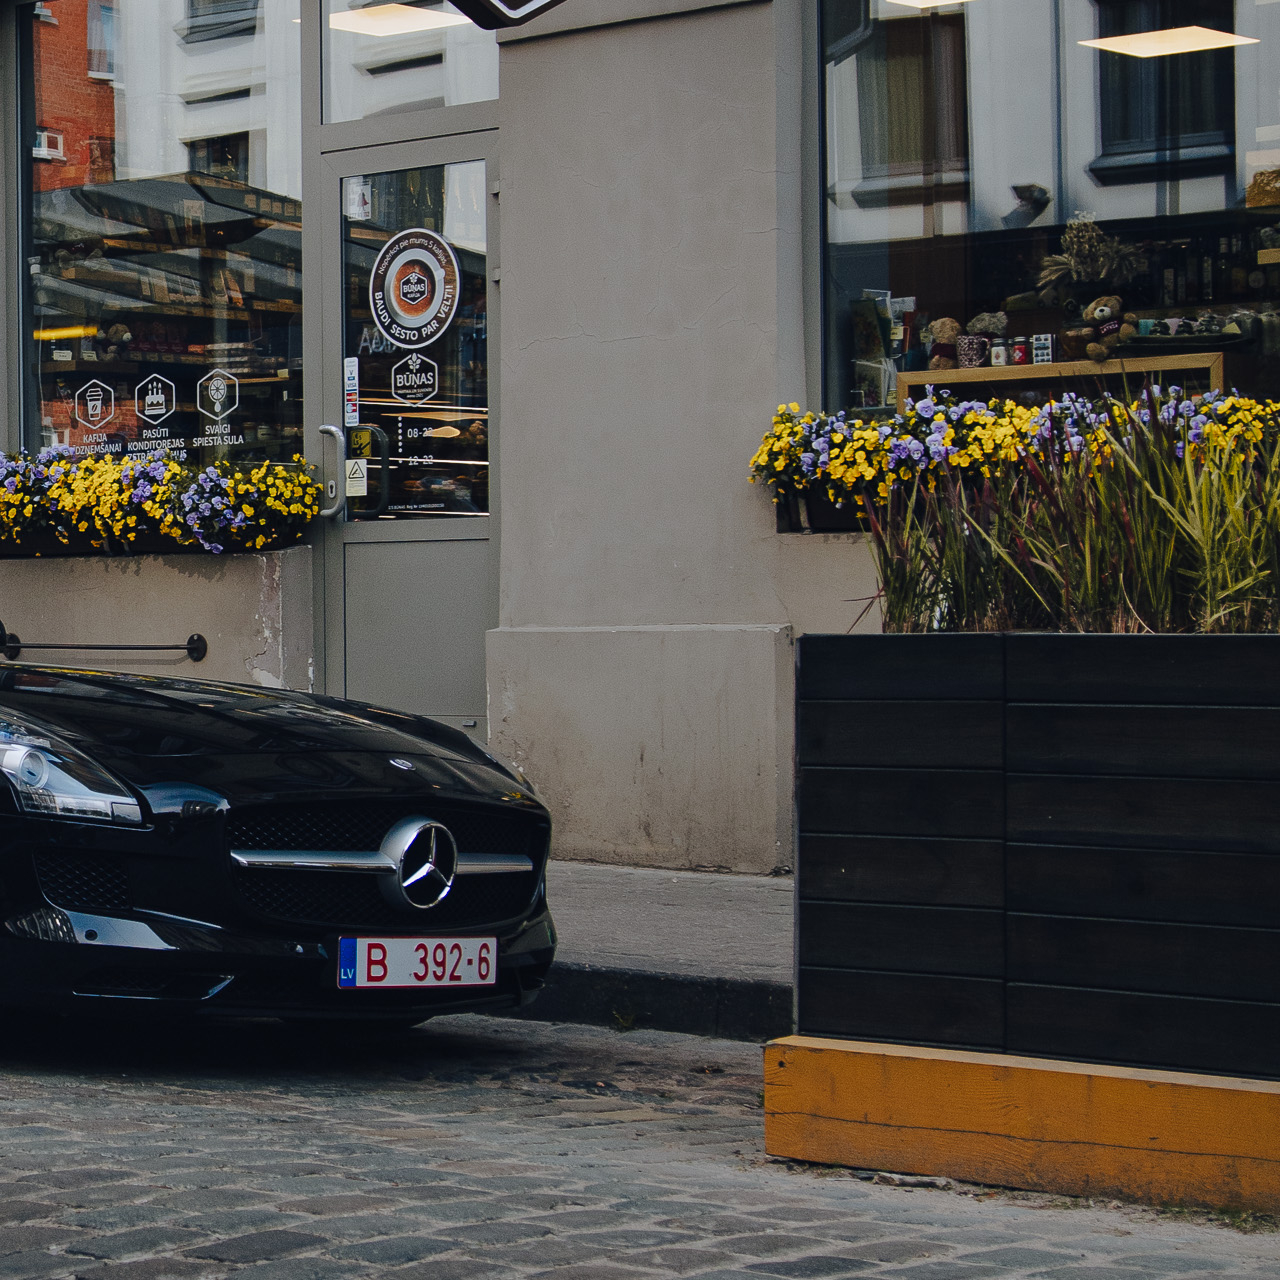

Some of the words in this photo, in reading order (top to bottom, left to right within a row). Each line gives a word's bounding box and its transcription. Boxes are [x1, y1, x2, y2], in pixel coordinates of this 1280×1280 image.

[399, 240, 409, 250] pie
[410, 238, 428, 246] mums
[375, 292, 392, 326] BAUDI
[390, 324, 419, 341] SESTO
[422, 320, 439, 338] PAR
[396, 372, 434, 388] BŪŅAS
[143, 427, 169, 439] PASŪTI
[205, 424, 231, 435] SVAIGI
[83, 433, 108, 444] KAFIJA
[193, 436, 223, 447] SPIESTA
[223, 435, 244, 445] SULA
[73, 443, 122, 457] DZŅEMŠANAI
[128, 439, 185, 451] KONDITOREJAS
[409, 455, 434, 466] 1222
[367, 943, 388, 982] B
[413, 943, 490, 982] 392-6
[341, 969, 354, 979] LV
